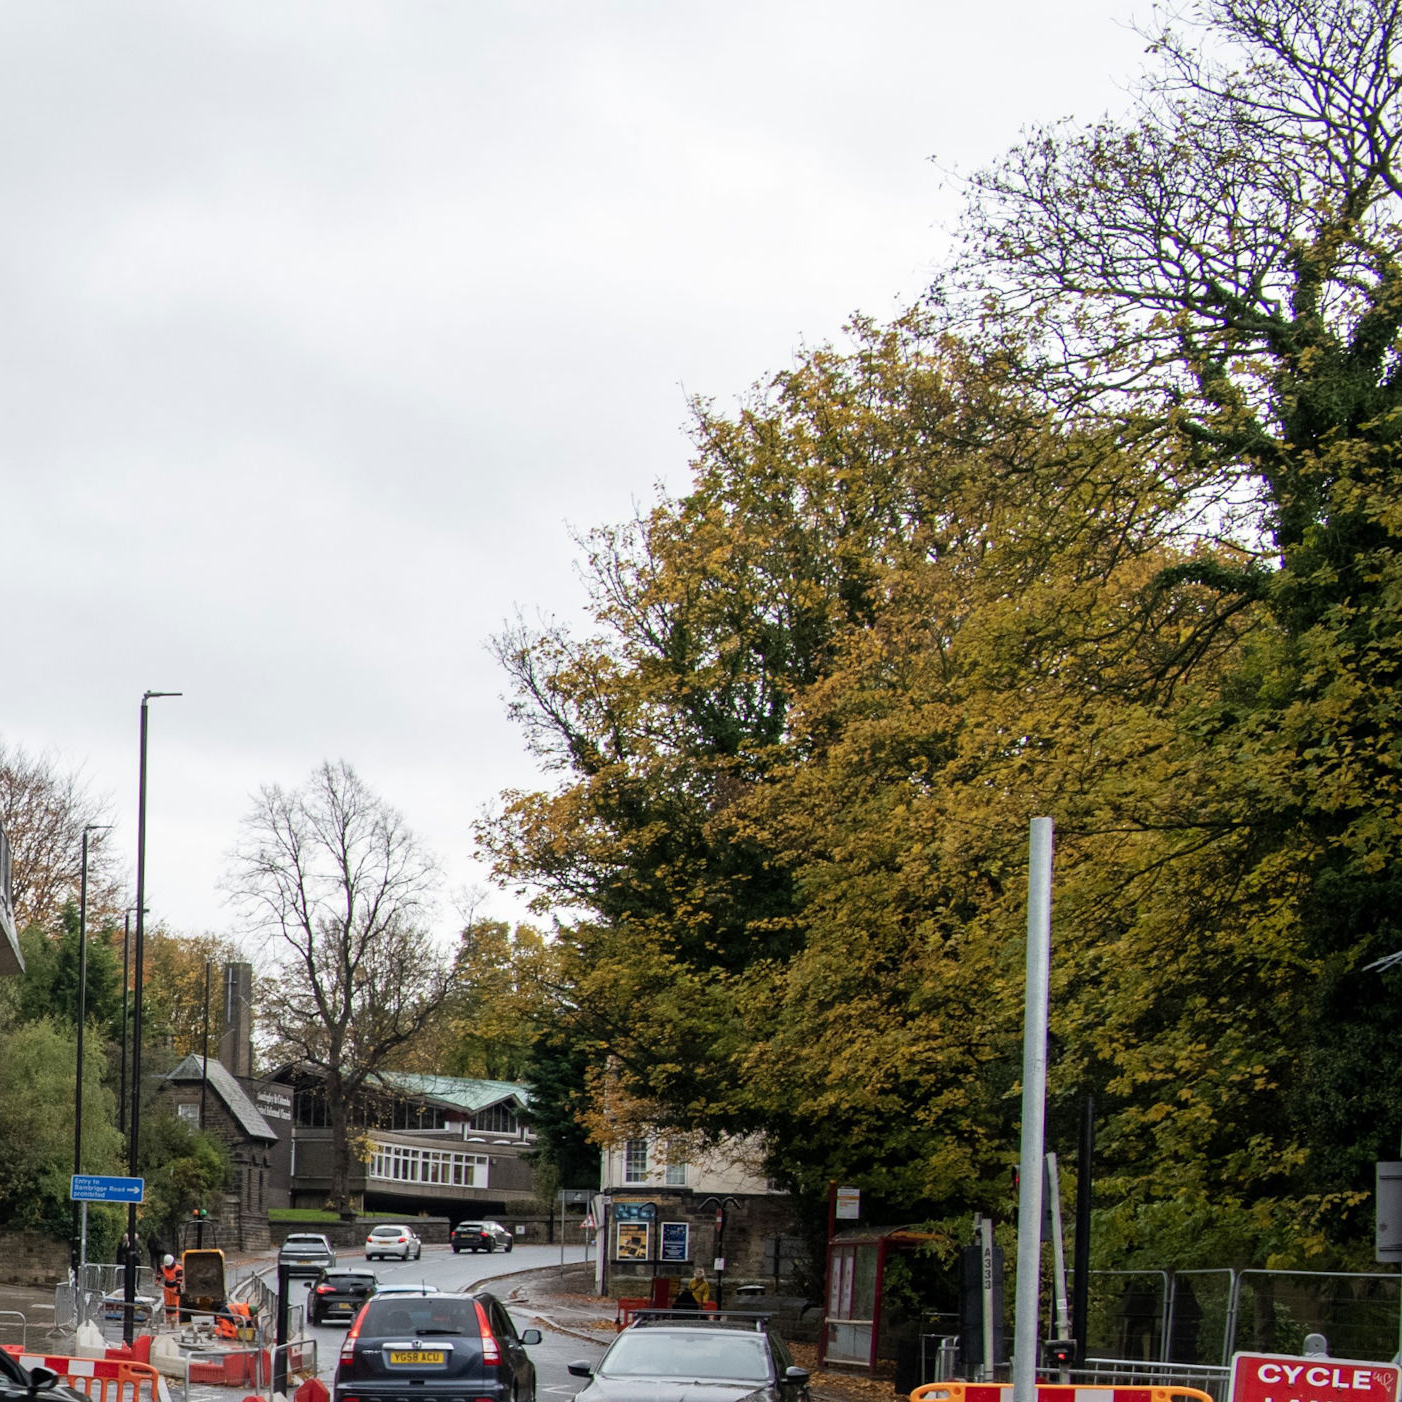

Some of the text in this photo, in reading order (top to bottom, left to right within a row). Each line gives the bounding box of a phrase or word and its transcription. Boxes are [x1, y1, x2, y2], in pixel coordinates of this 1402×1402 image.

[984, 1247, 992, 1290] A333
[394, 1353, 440, 1362] YG58 ACU
[1257, 1363, 1372, 1390] CYCLE
